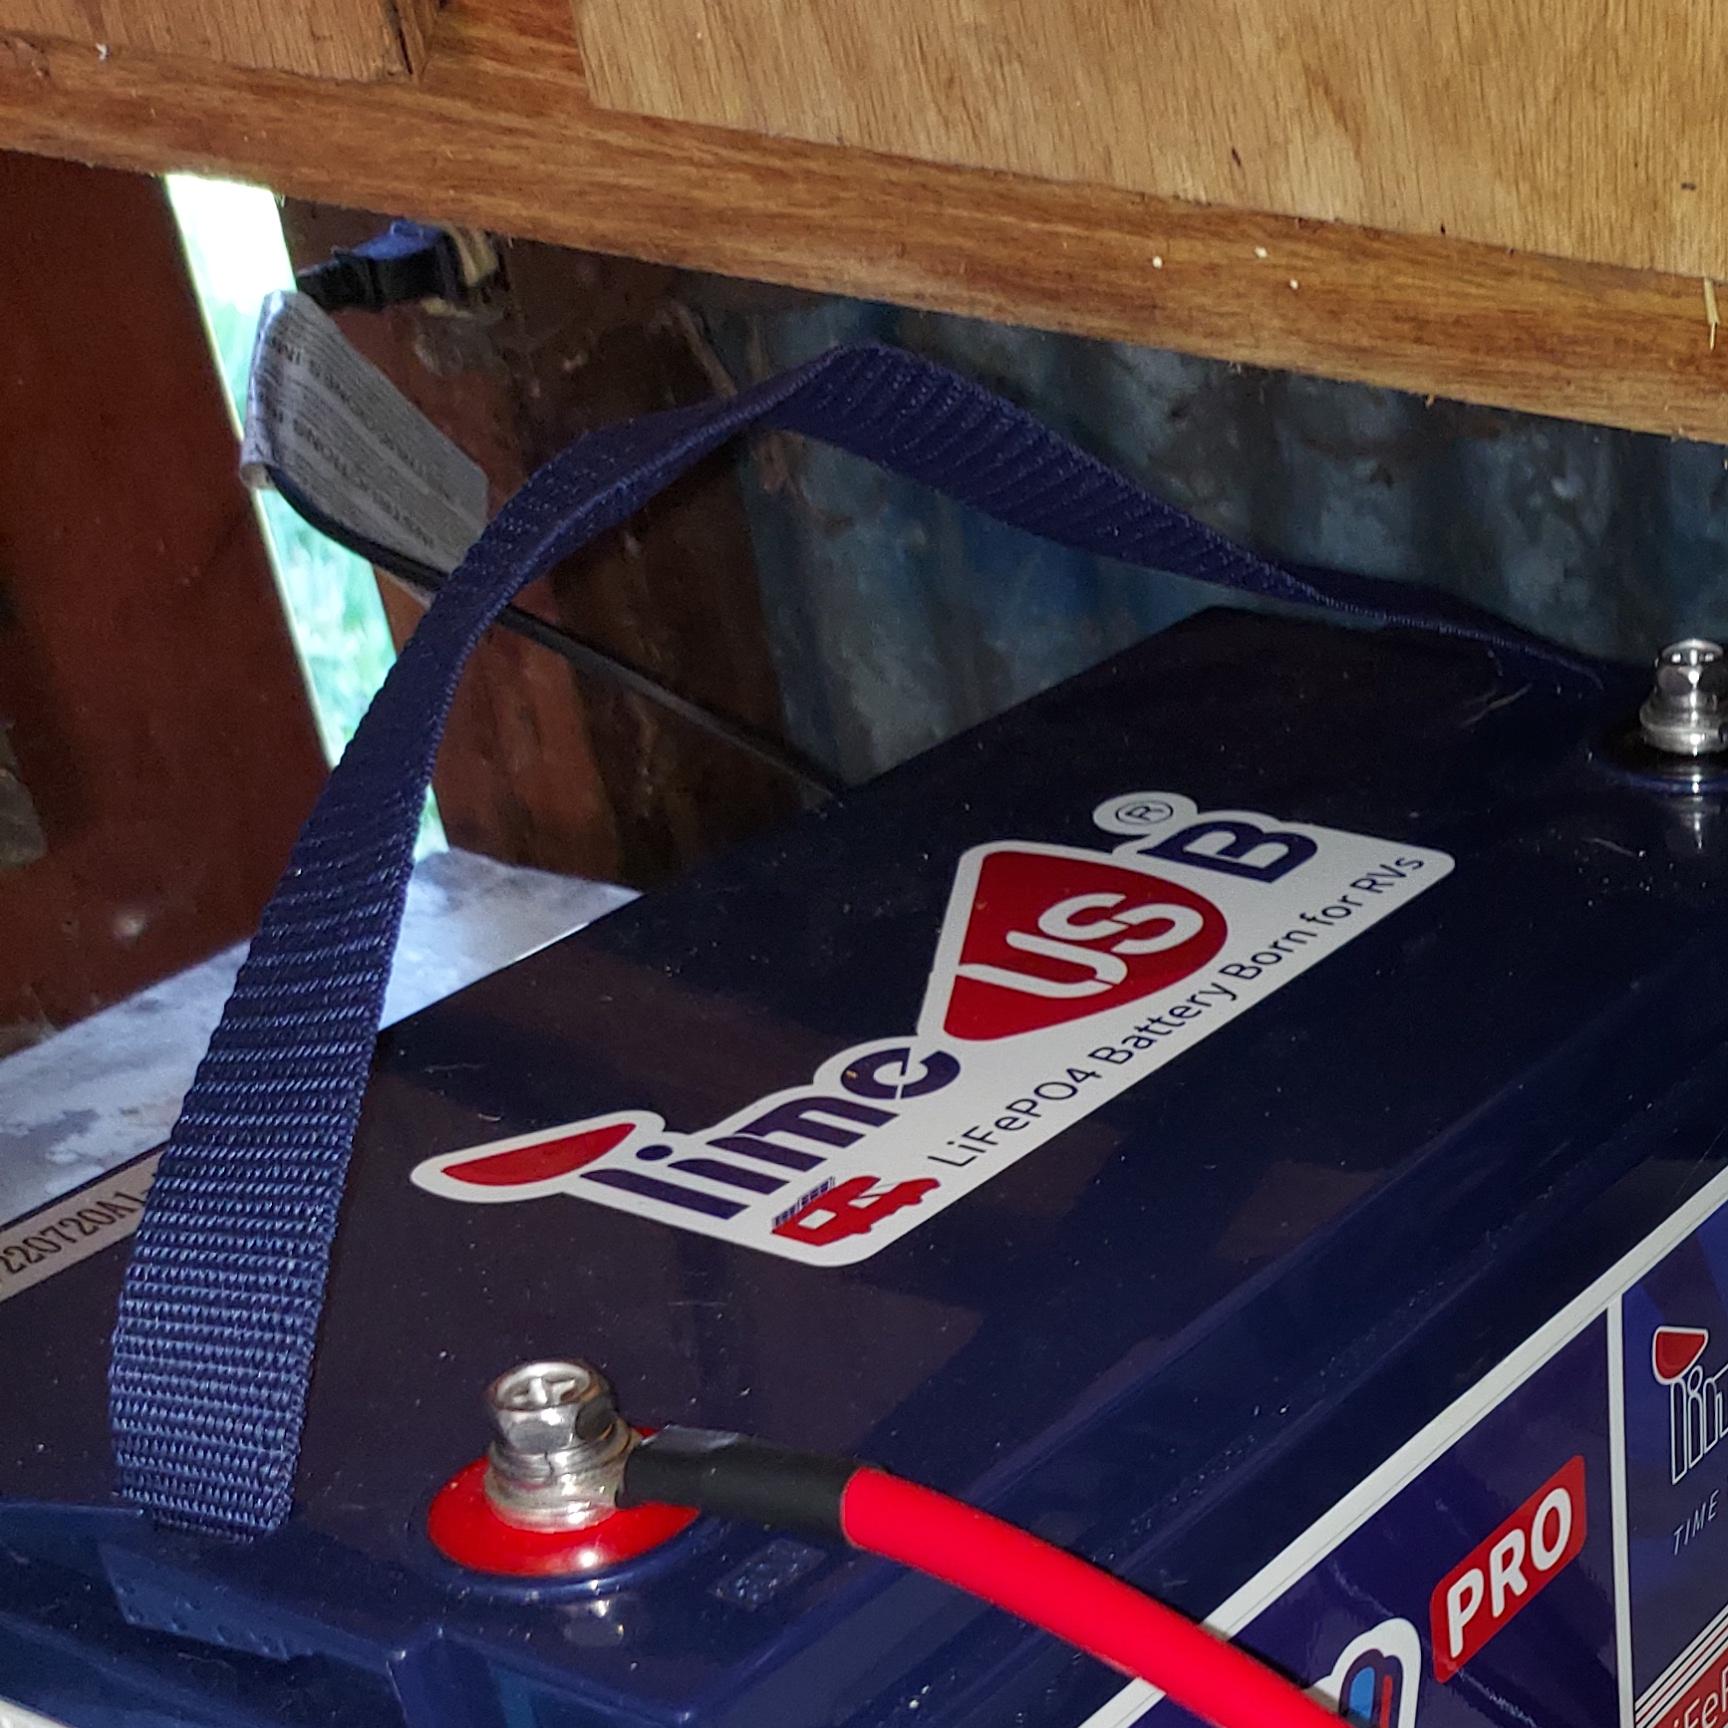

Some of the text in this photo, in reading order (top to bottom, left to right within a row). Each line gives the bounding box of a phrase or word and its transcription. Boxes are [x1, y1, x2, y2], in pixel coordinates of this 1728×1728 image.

[927, 854, 1426, 1168] LiFePO4 Battery Born for RVs
[1445, 1486, 1575, 1659] PRO
[1672, 1491, 1720, 1557] TIME
